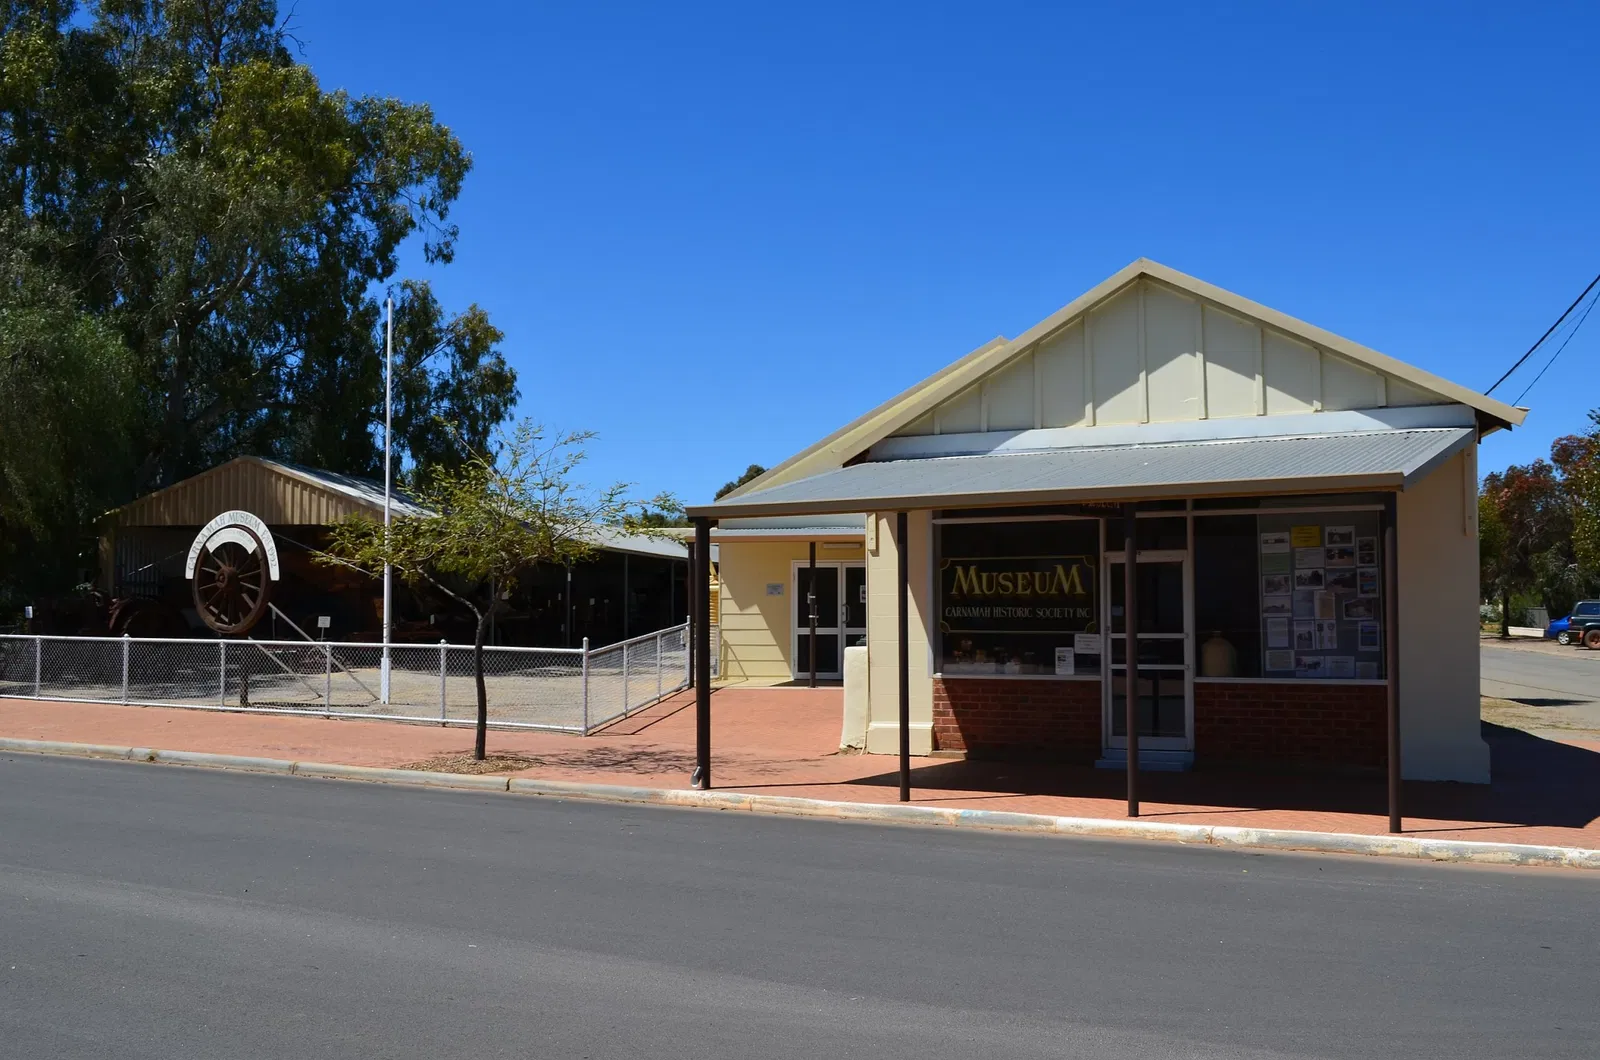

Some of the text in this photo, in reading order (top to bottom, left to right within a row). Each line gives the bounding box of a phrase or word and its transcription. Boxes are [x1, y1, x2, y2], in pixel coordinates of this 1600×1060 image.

[188, 516, 226, 571] CARNAMAH
[228, 512, 261, 533] MUSEUM
[945, 605, 991, 618] CARNAMAH
[993, 606, 1033, 618] HISTORIC
[1035, 607, 1077, 619] SOCIETY
